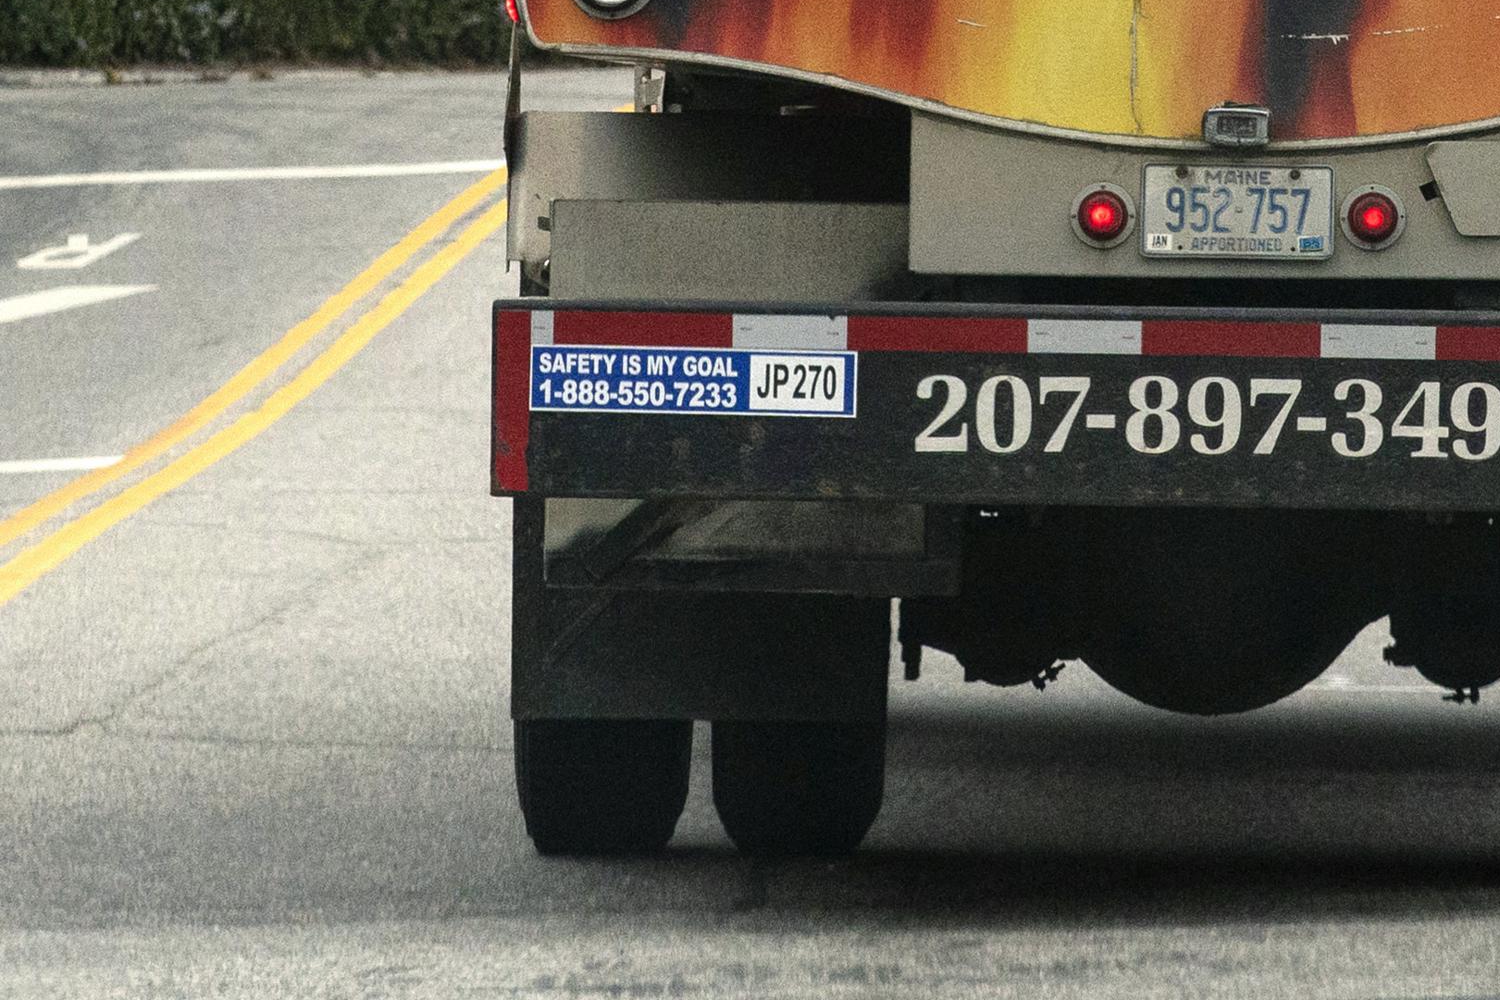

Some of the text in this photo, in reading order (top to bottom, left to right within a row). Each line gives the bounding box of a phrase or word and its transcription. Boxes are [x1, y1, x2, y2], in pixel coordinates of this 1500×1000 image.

[1205, 169, 1272, 185] MAINE
[1165, 186, 1311, 235] 952 757
[1191, 237, 1282, 251] APPORTIONED
[539, 352, 738, 378] SAFETY IS MY GOAL
[539, 378, 738, 408] 1-888-550-7233
